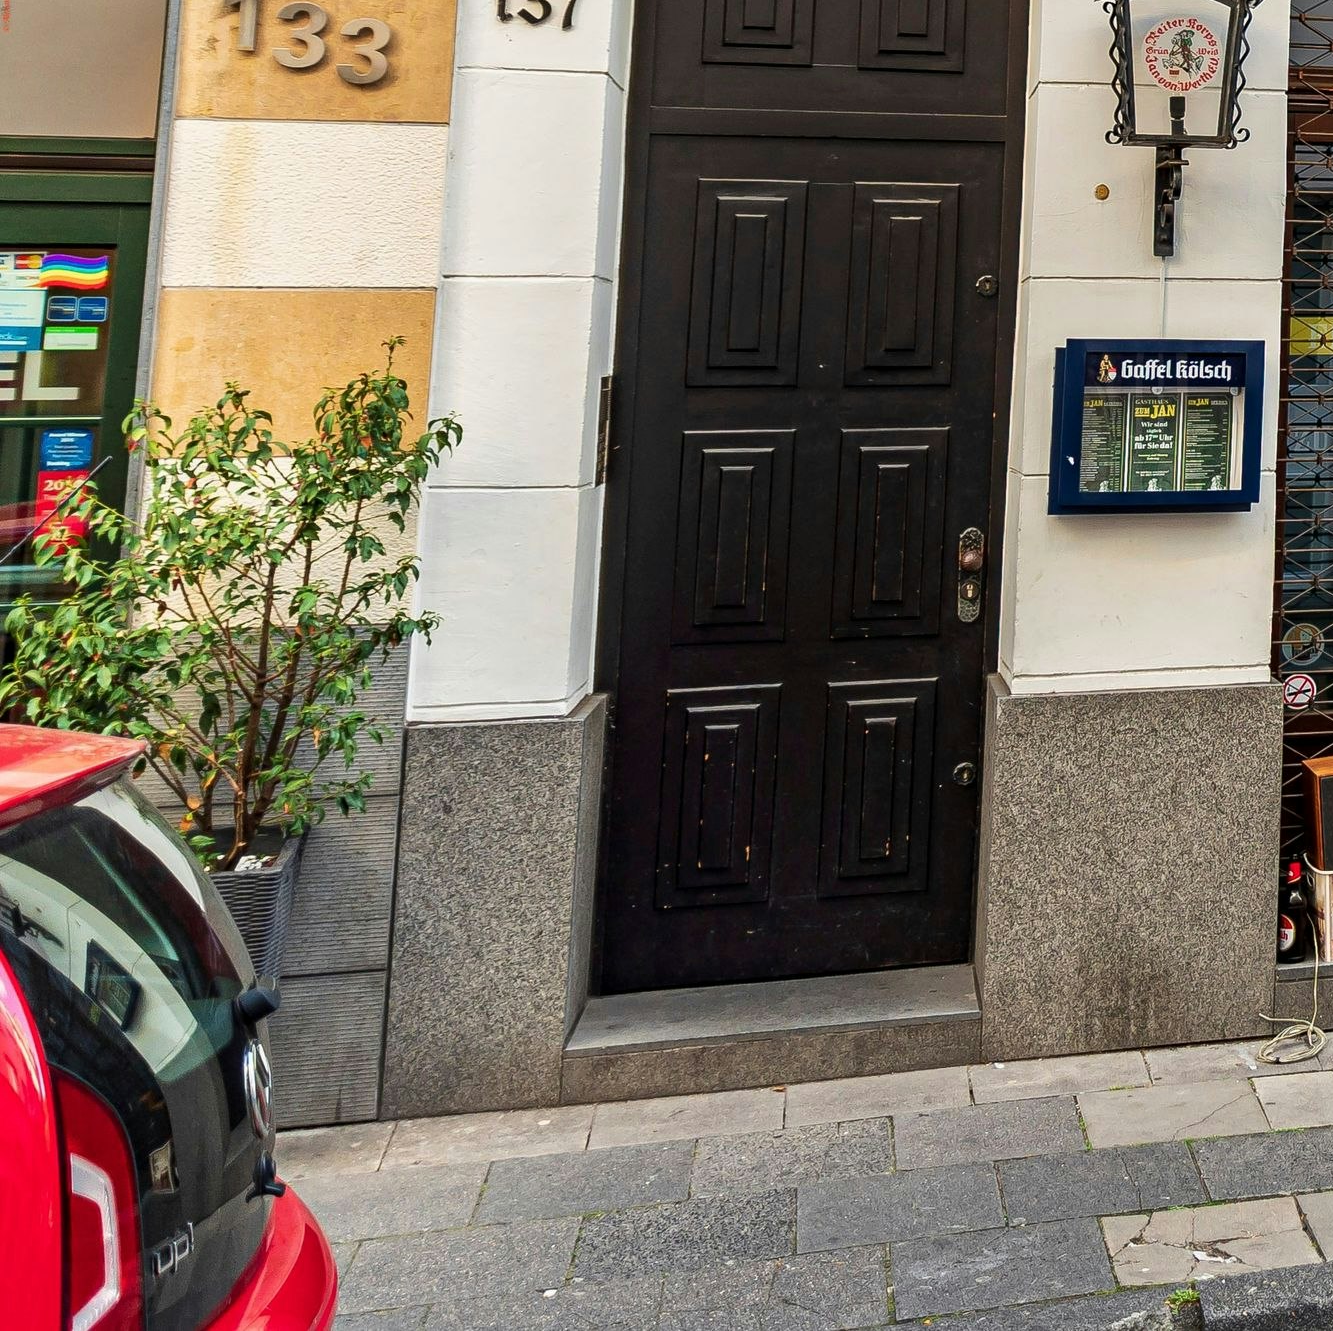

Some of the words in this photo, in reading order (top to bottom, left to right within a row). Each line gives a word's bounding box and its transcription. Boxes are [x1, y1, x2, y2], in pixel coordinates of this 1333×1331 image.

[1145, 19, 1184, 46] Reiter
[1185, 18, 1217, 47] Korps
[1145, 46, 1169, 55] Grün
[1121, 358, 1173, 382] Gaffel
[1175, 358, 1232, 382] Kölsch
[1134, 407, 1150, 416] ZUM
[1150, 404, 1176, 419] JAN
